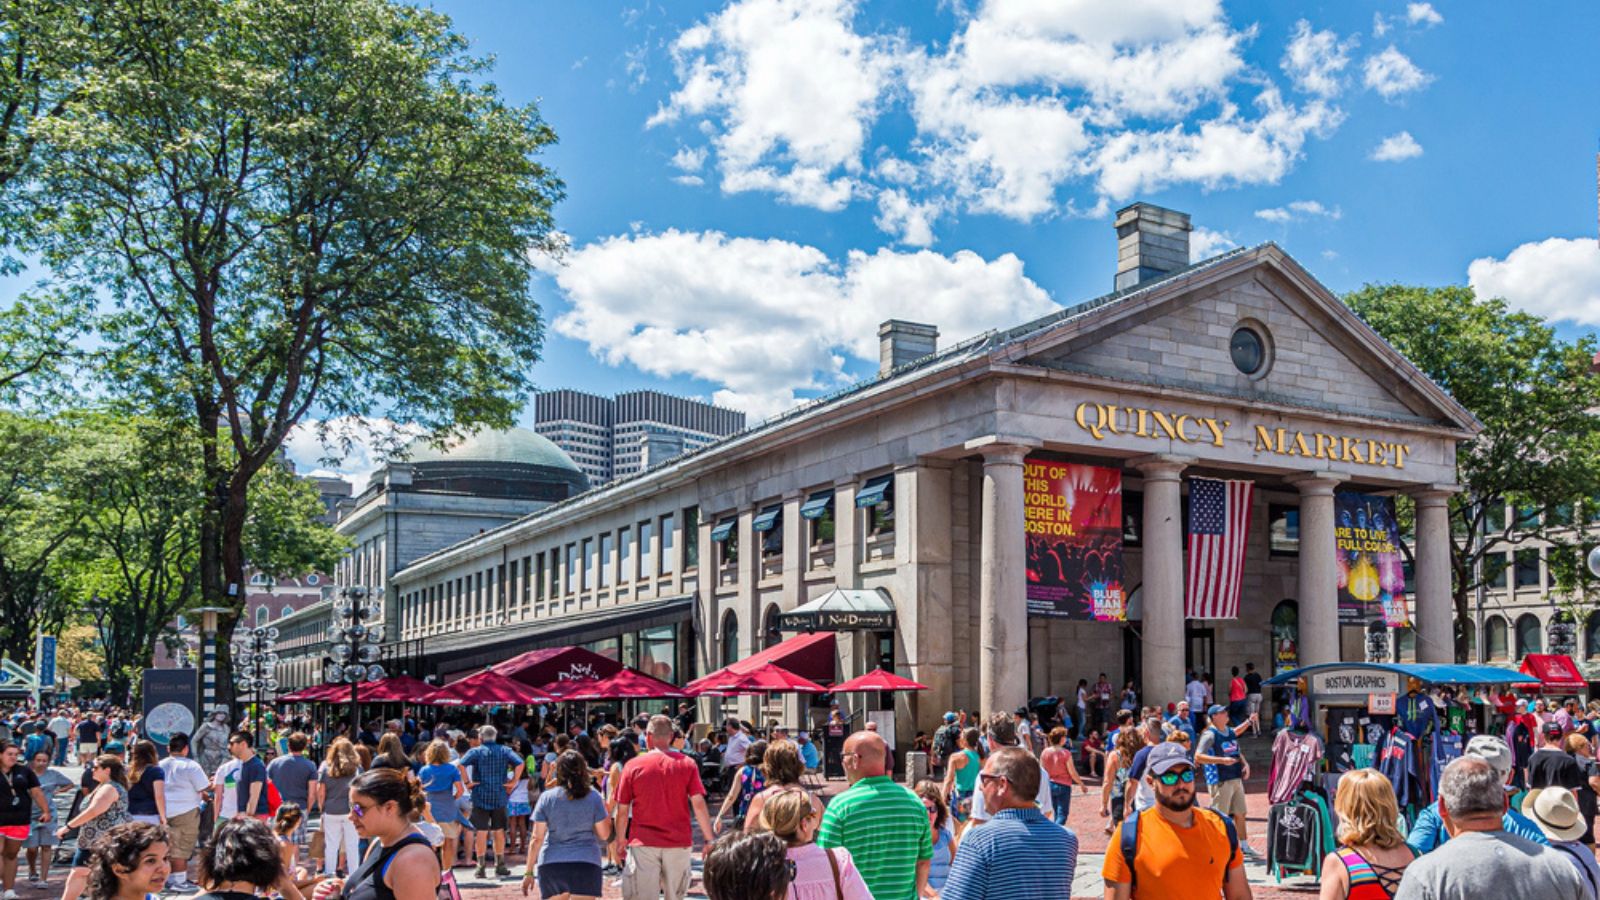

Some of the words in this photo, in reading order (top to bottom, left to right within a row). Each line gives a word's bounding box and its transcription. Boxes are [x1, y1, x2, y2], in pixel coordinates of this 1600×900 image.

[1075, 402, 1231, 447] QUINCY
[1255, 425, 1410, 469] MARKET
[1049, 467, 1067, 480] OF
[1058, 509, 1071, 522] IN
[1354, 529, 1367, 539] TO
[1338, 539, 1362, 551] FULL
[1094, 589, 1120, 599] BLUE
[1094, 599, 1120, 609] MAN
[1325, 676, 1352, 689] BOSTON
[1353, 675, 1386, 689] GRAPHICS
